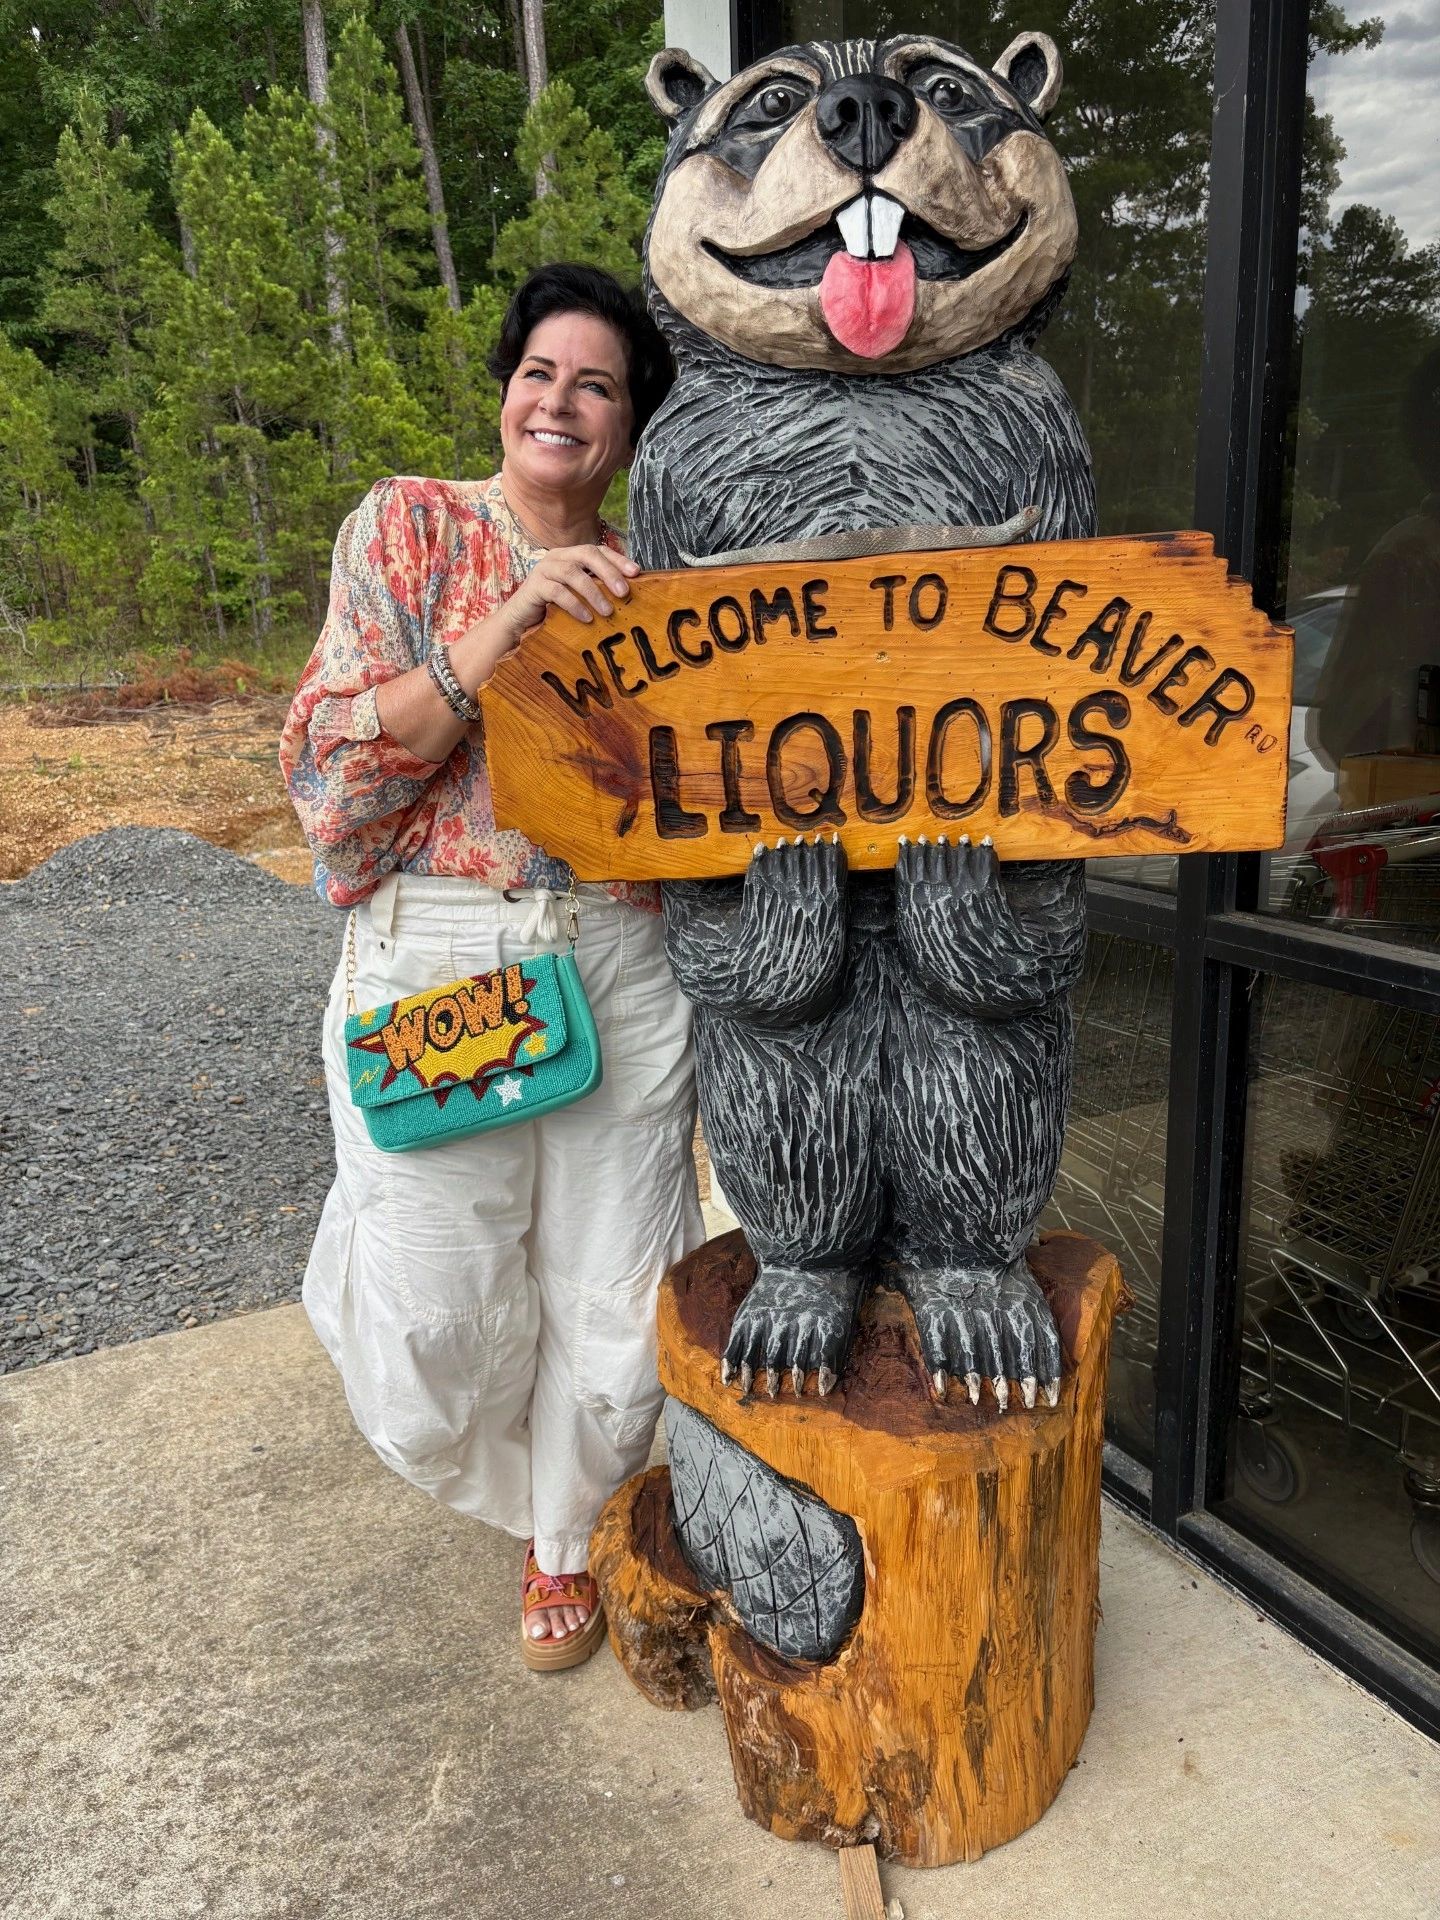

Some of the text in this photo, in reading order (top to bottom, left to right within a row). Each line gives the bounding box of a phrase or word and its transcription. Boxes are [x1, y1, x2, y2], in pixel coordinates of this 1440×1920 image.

[541, 564, 1256, 747] WELCOME TO BEAVER
[648, 689, 1132, 840] LIQUORS
[381, 963, 531, 1072] WOW!
